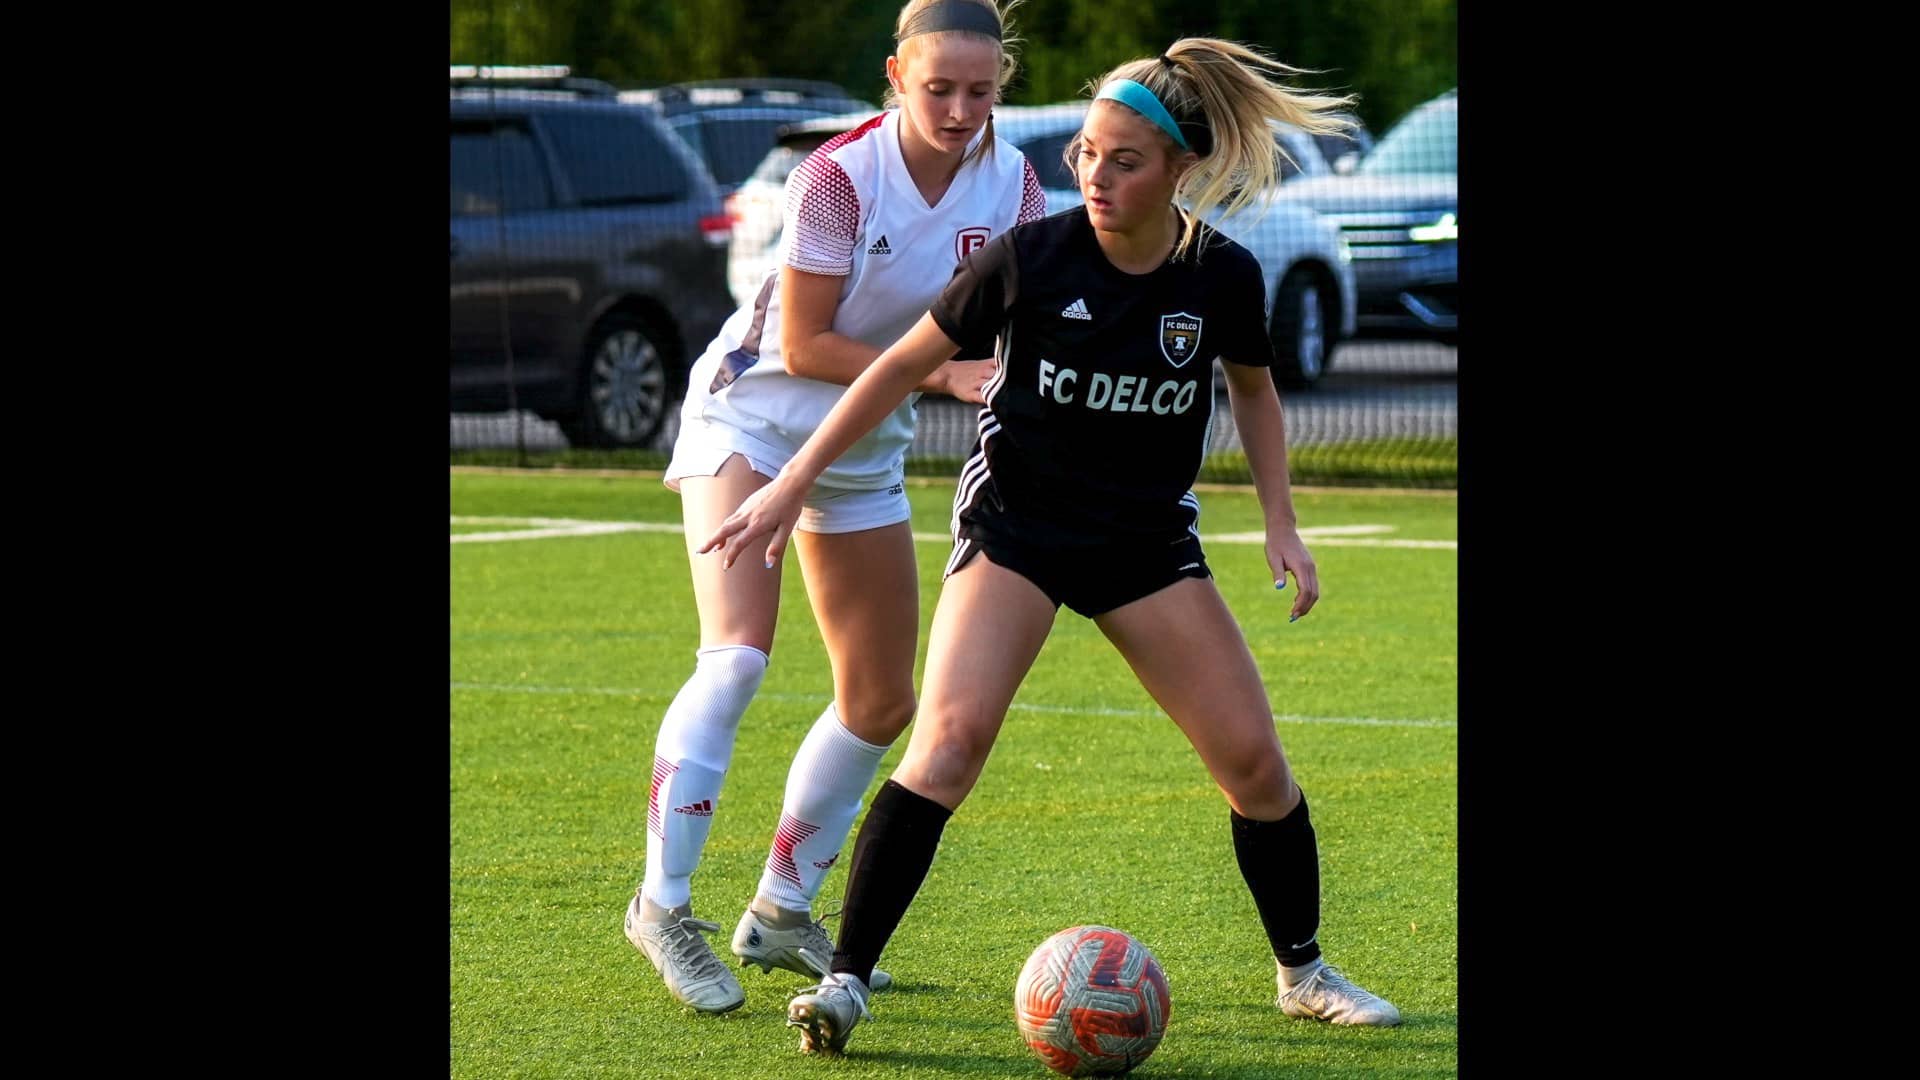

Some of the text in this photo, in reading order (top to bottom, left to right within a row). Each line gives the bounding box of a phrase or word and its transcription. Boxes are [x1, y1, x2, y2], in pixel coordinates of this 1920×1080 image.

[1062, 310, 1092, 320] adidas
[1166, 321, 1198, 330] FC DELCO
[1038, 359, 1198, 415] FC DELCO
